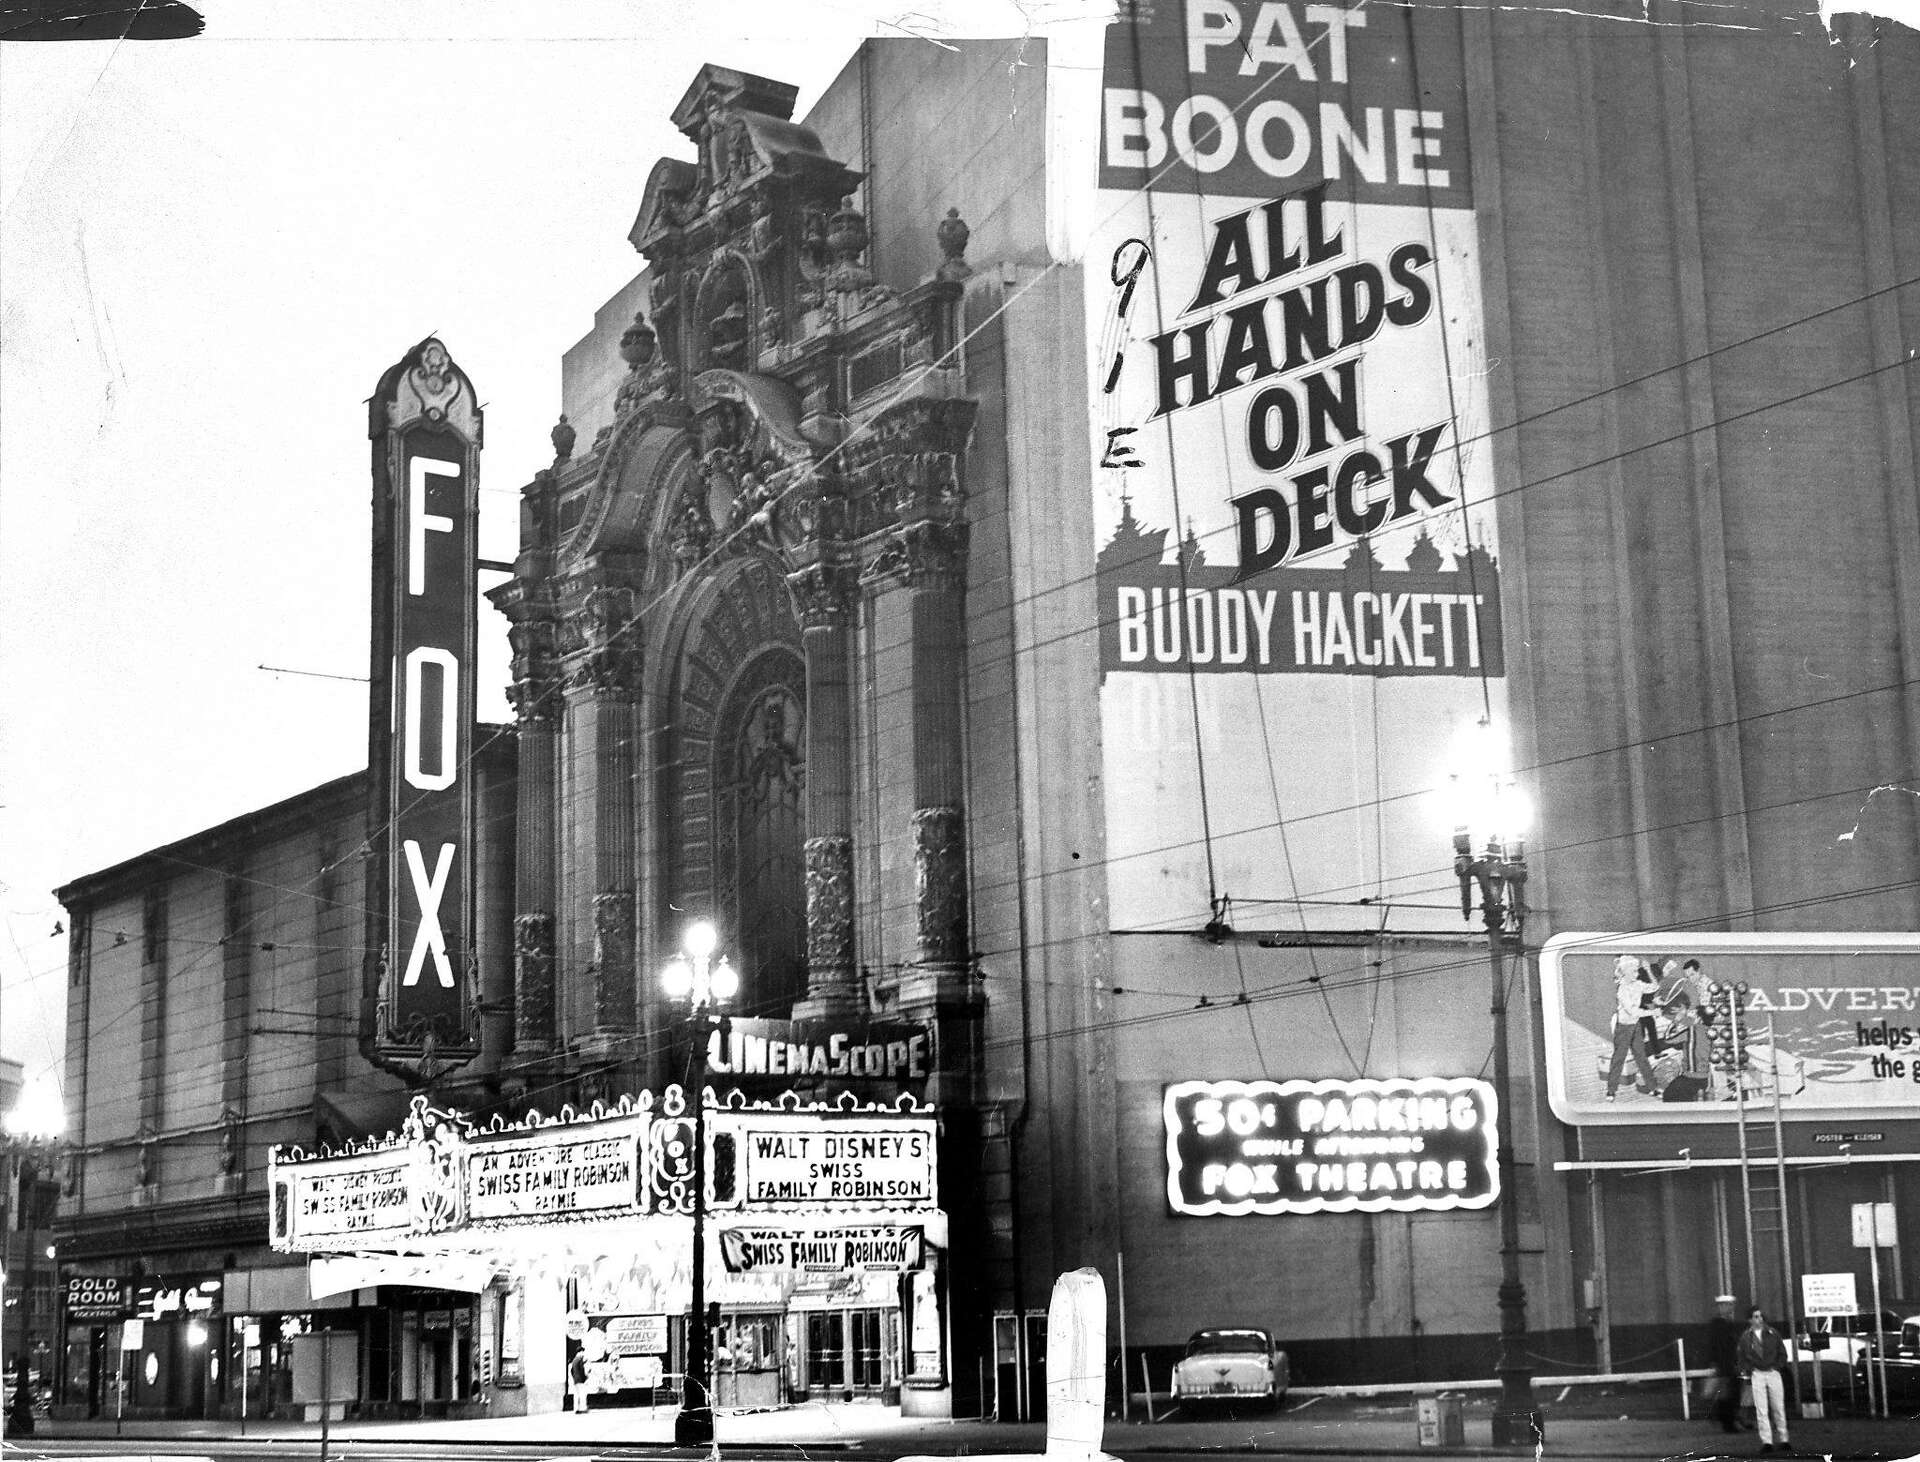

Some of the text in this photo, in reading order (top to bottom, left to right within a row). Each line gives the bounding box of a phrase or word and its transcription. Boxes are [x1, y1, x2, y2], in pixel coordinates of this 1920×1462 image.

[1186, 0, 1367, 83] PAT
[1104, 88, 1450, 188] BOONE
[1178, 178, 1347, 319] ALL
[1144, 242, 1437, 422] HANDS
[1246, 353, 1366, 473] ON
[1226, 416, 1458, 586] DECK
[1117, 586, 1484, 668] BUDDY HACKETT
[403, 455, 460, 988] FOX
[1856, 1020, 1913, 1050] helps
[1871, 1053, 1905, 1078] the
[1299, 1095, 1477, 1132] PARKING
[483, 1155, 499, 1172] AN
[509, 1148, 573, 1169] ADVENURE
[756, 1137, 810, 1158] WALT
[478, 1161, 630, 1196] SWISS FAMILY ROBINSON
[810, 1163, 863, 1178] SWISS
[1203, 1160, 1467, 1197] FOX THEATRE
[758, 1180, 922, 1198] FAMILY ROBINSON
[303, 1197, 335, 1215] SWSS
[750, 1228, 896, 1240] WALT DISNEY'S
[740, 1241, 907, 1270] SWISS FAMILY ROBINSON
[67, 1291, 120, 1304] ROOM
[69, 1278, 117, 1291] GOLD
